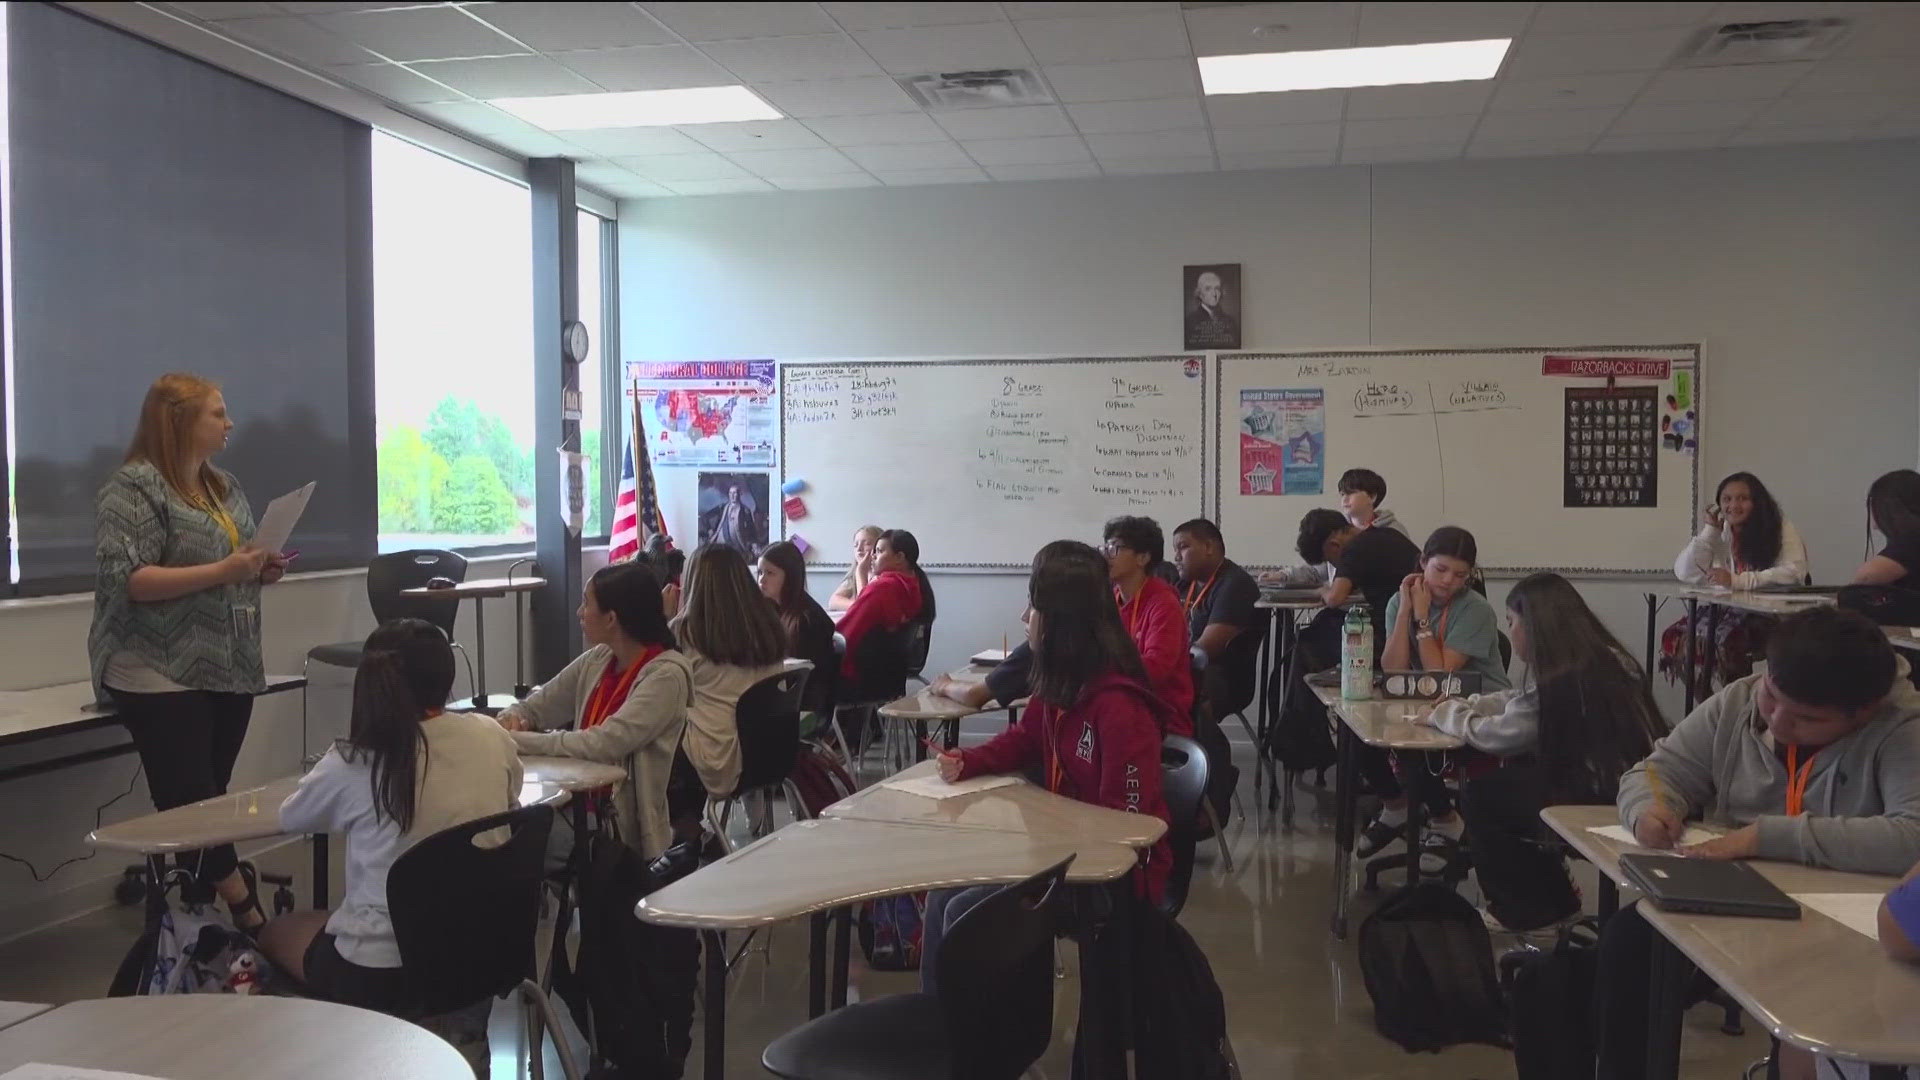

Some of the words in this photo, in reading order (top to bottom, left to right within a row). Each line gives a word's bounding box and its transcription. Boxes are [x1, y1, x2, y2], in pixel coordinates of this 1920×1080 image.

[1571, 361, 1635, 376] RAZORBACKS
[1637, 363, 1664, 376] DRIVE
[1285, 391, 1321, 401] Government
